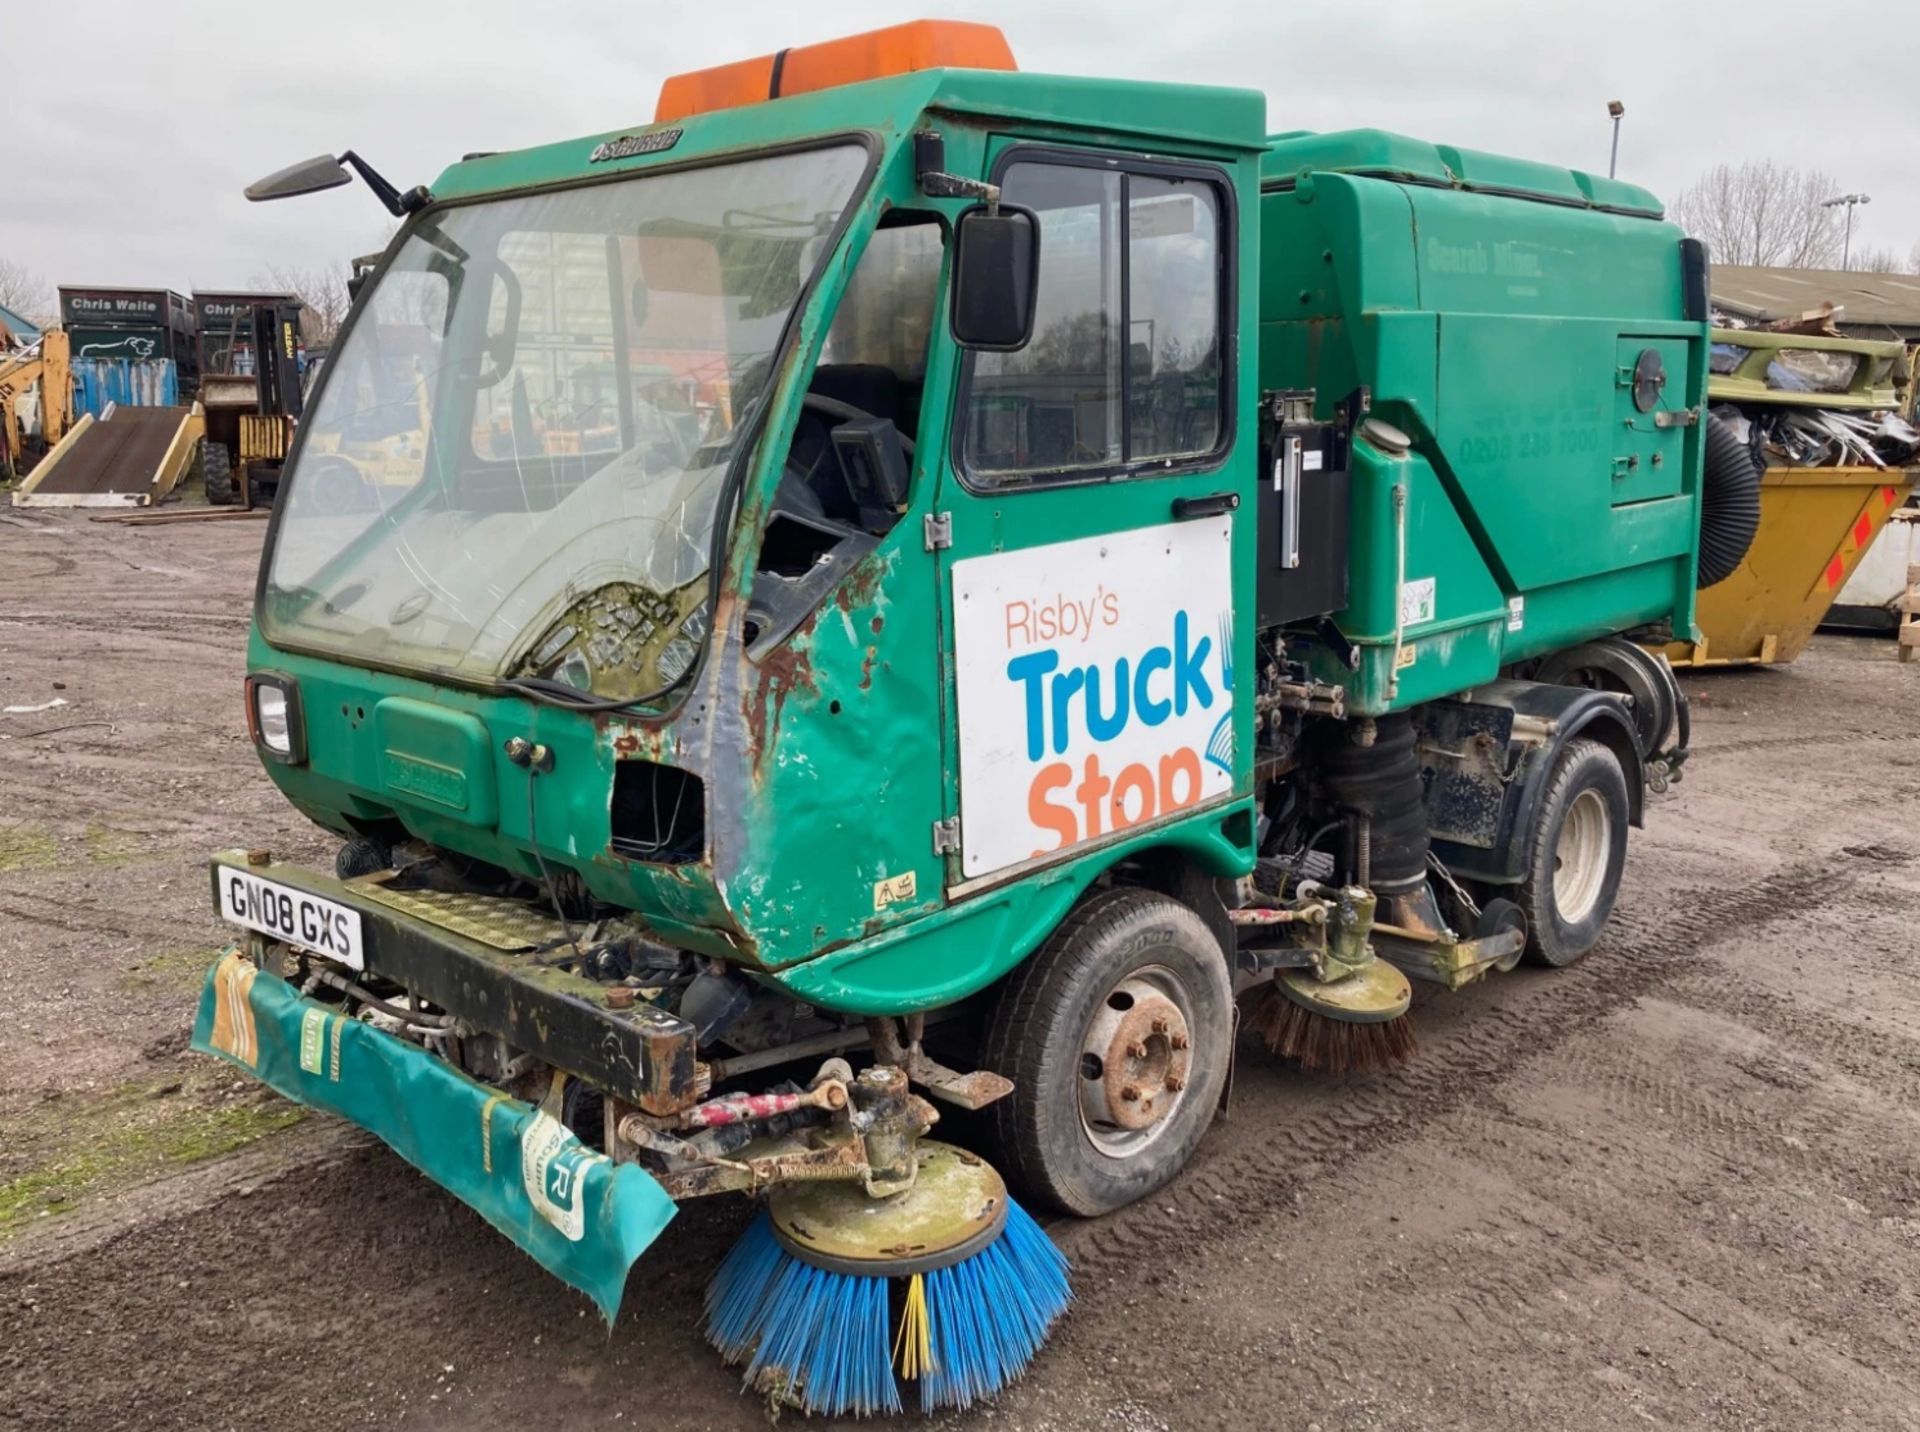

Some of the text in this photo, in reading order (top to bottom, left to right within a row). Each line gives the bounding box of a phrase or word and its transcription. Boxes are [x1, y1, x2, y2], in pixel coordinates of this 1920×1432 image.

[71, 298, 157, 312] Chris Waite
[284, 322, 294, 359] HYSTER
[1005, 584, 1120, 649] Risby's
[1007, 609, 1213, 763] Truck
[1027, 746, 1203, 860] Stop
[230, 876, 351, 957] GN08 GXS
